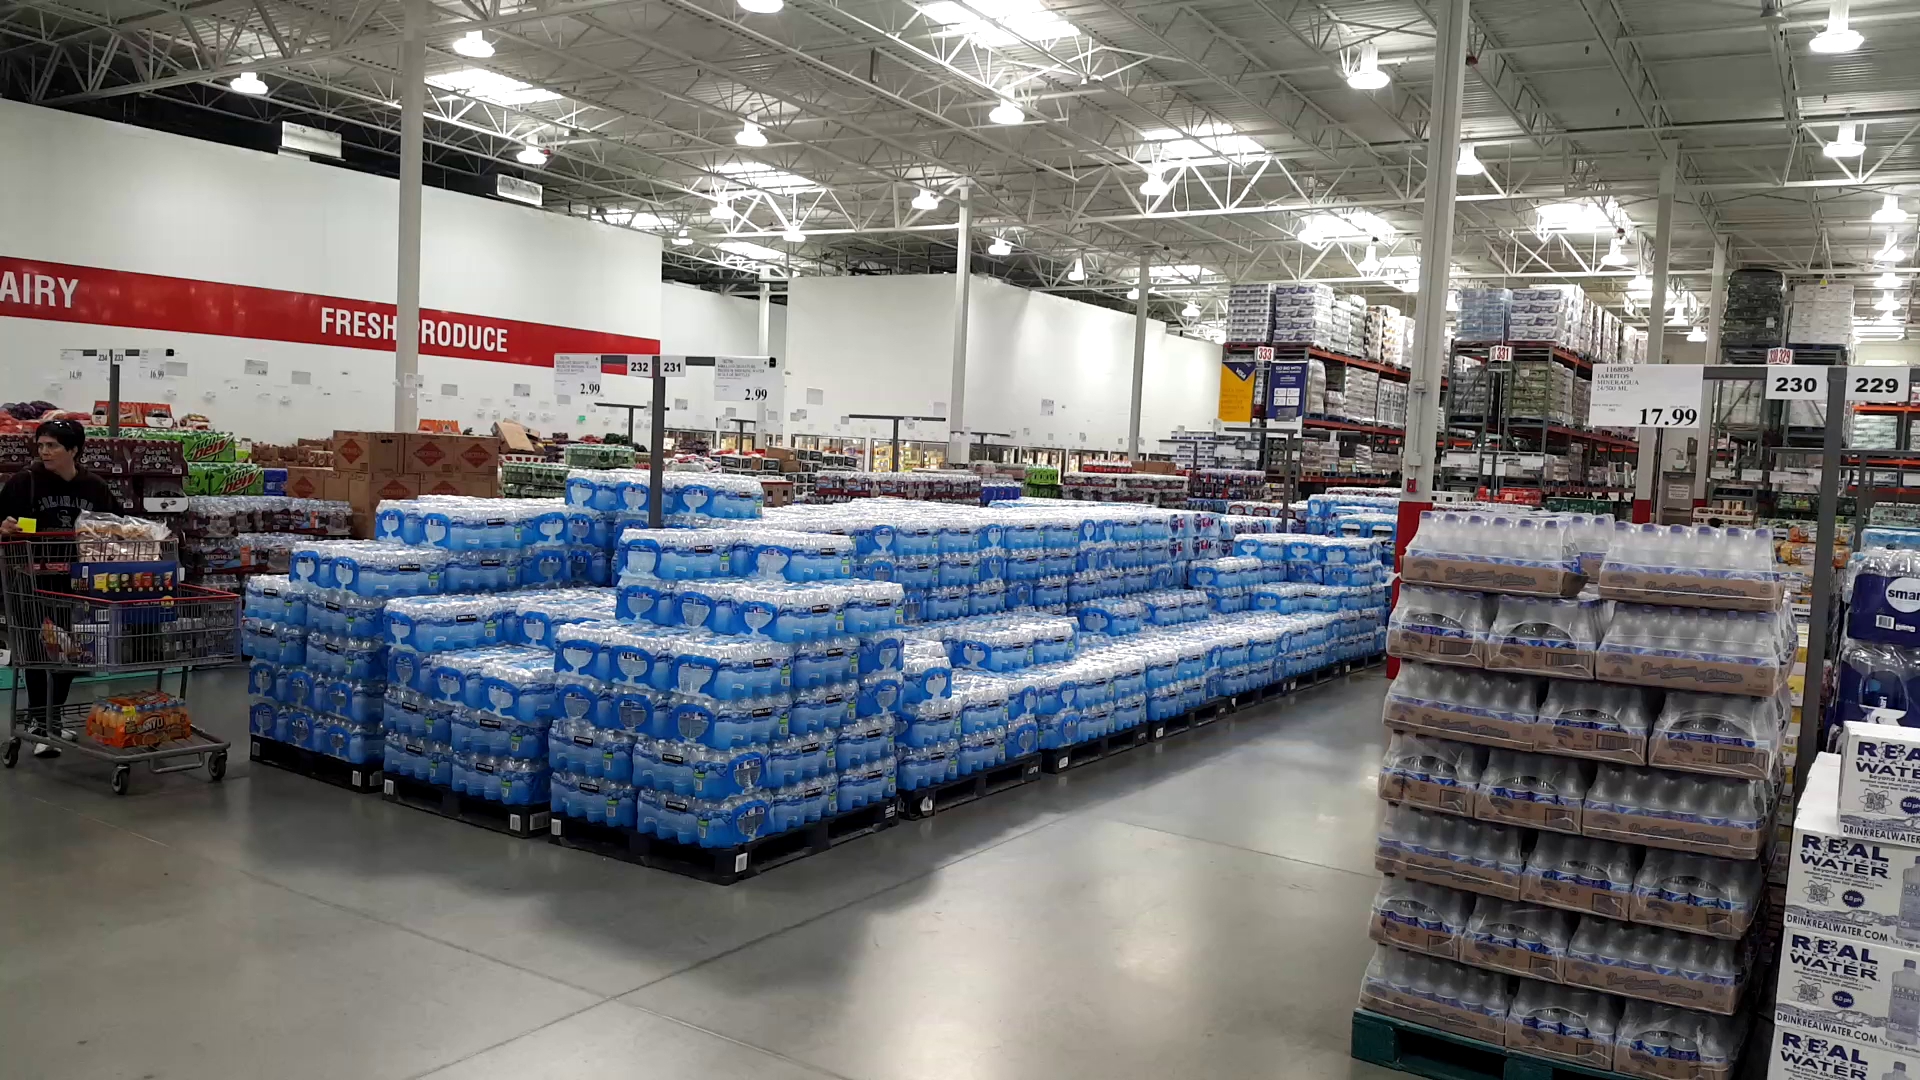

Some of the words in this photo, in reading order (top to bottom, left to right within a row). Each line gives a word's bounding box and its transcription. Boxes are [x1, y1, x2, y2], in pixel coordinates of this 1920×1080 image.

[0, 271, 79, 308] AIRY
[320, 306, 398, 341] FRESH
[417, 317, 508, 353] RODUCE
[1258, 347, 1273, 360] 333
[630, 362, 649, 372] 232
[663, 363, 682, 373] 231
[579, 382, 601, 395] 2.99
[1774, 376, 1818, 393] 230
[1854, 377, 1900, 394] 229
[744, 388, 768, 401] 2.99
[1639, 407, 1698, 427] 17.99
[1887, 588, 1920, 601] smar
[1857, 741, 1920, 761] REA
[1856, 756, 1920, 768] ALKALI
[1856, 761, 1920, 780] WATE
[1843, 824, 1920, 845] DRINKREALWATER
[1800, 853, 1889, 880] WATER
[1786, 914, 1888, 943] DRINKREALWATER.COM
[1789, 952, 1879, 982] WATER
[1776, 1012, 1878, 1044] DRINKREALWATER.COM
[1780, 1050, 1868, 1080] WATER
